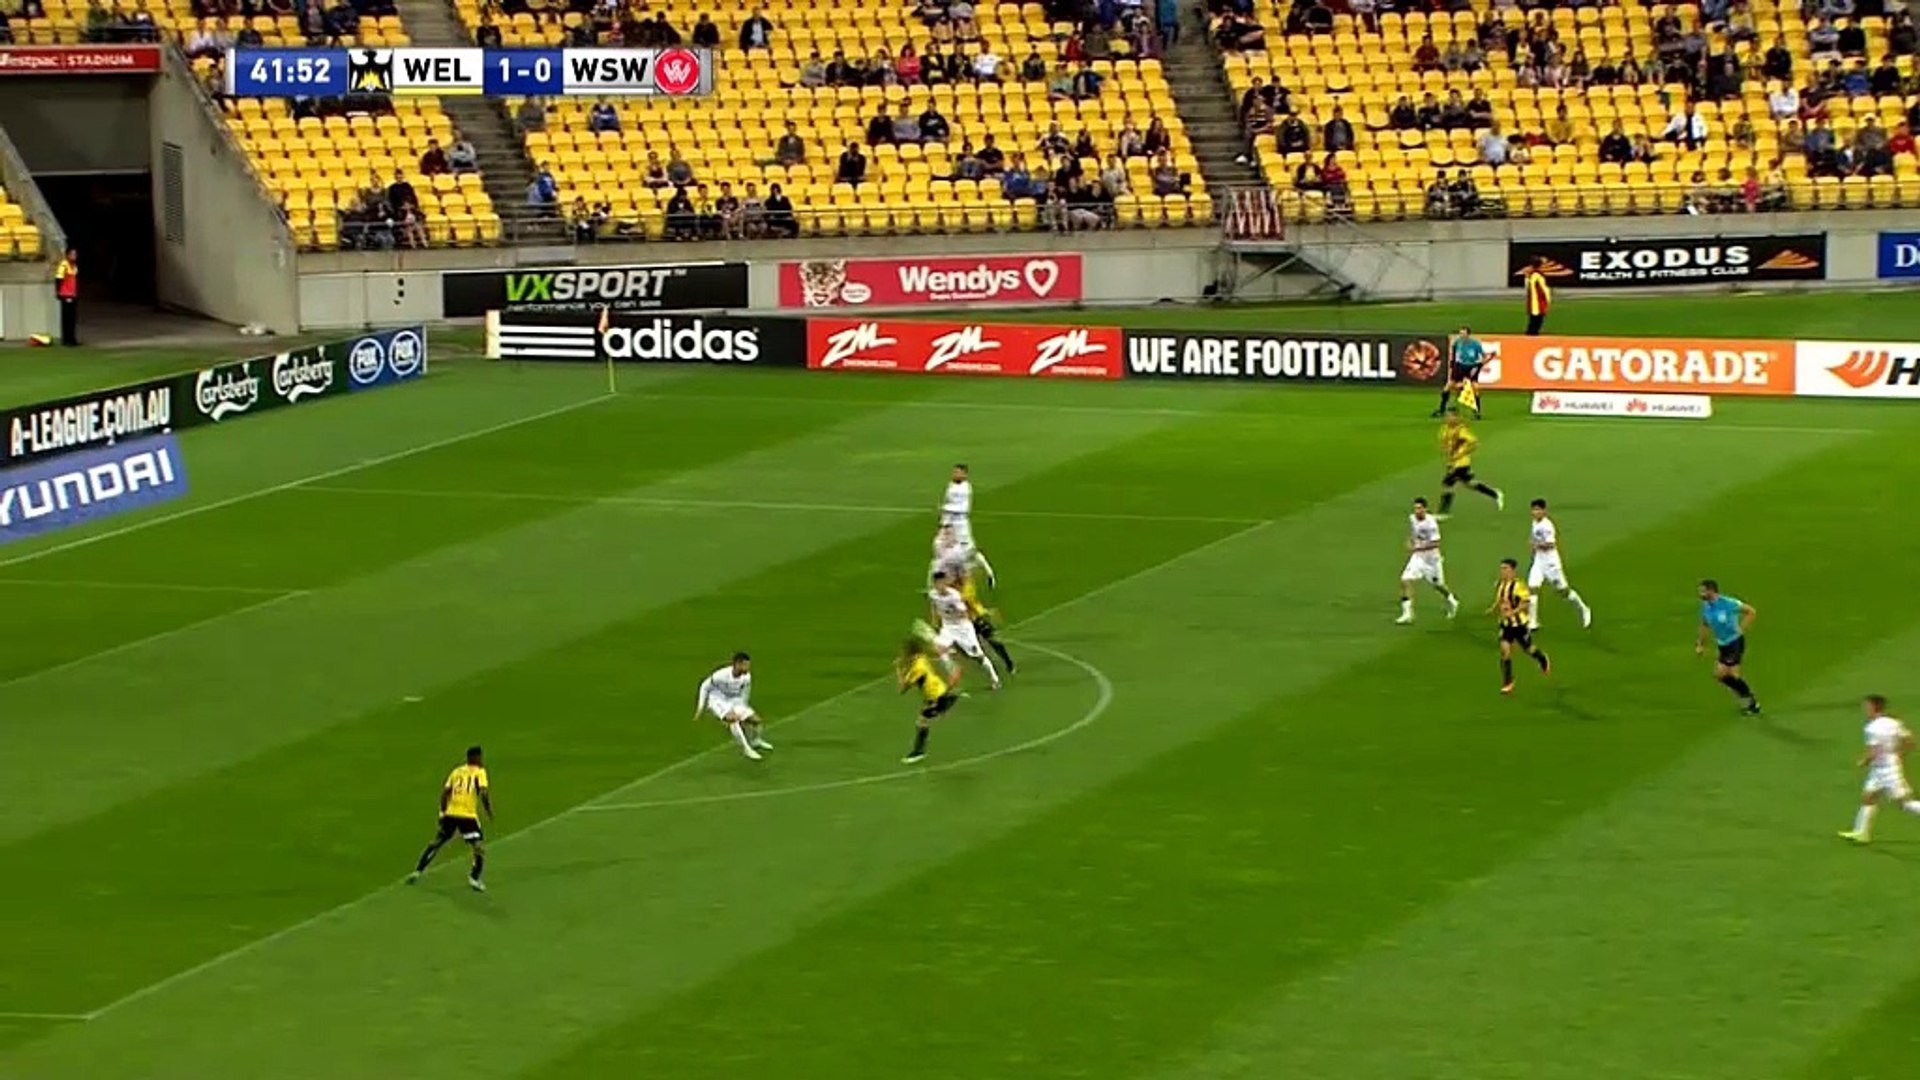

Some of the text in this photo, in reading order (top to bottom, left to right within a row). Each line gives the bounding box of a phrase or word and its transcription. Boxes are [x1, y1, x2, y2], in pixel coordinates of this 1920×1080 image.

[67, 54, 134, 66] STADIUM
[1579, 266, 1749, 280] HEALTH & FITNESS CLUB
[1580, 246, 1749, 270] EXODUS
[505, 270, 671, 301] VXSPORT
[900, 264, 1021, 296] Wendys
[602, 319, 758, 361] adidas
[272, 345, 334, 396] Carlsberg
[1129, 337, 1396, 379] WE ARE FOOTBALL
[1533, 346, 1768, 385] GATORADE
[195, 362, 260, 414] Carlsberg
